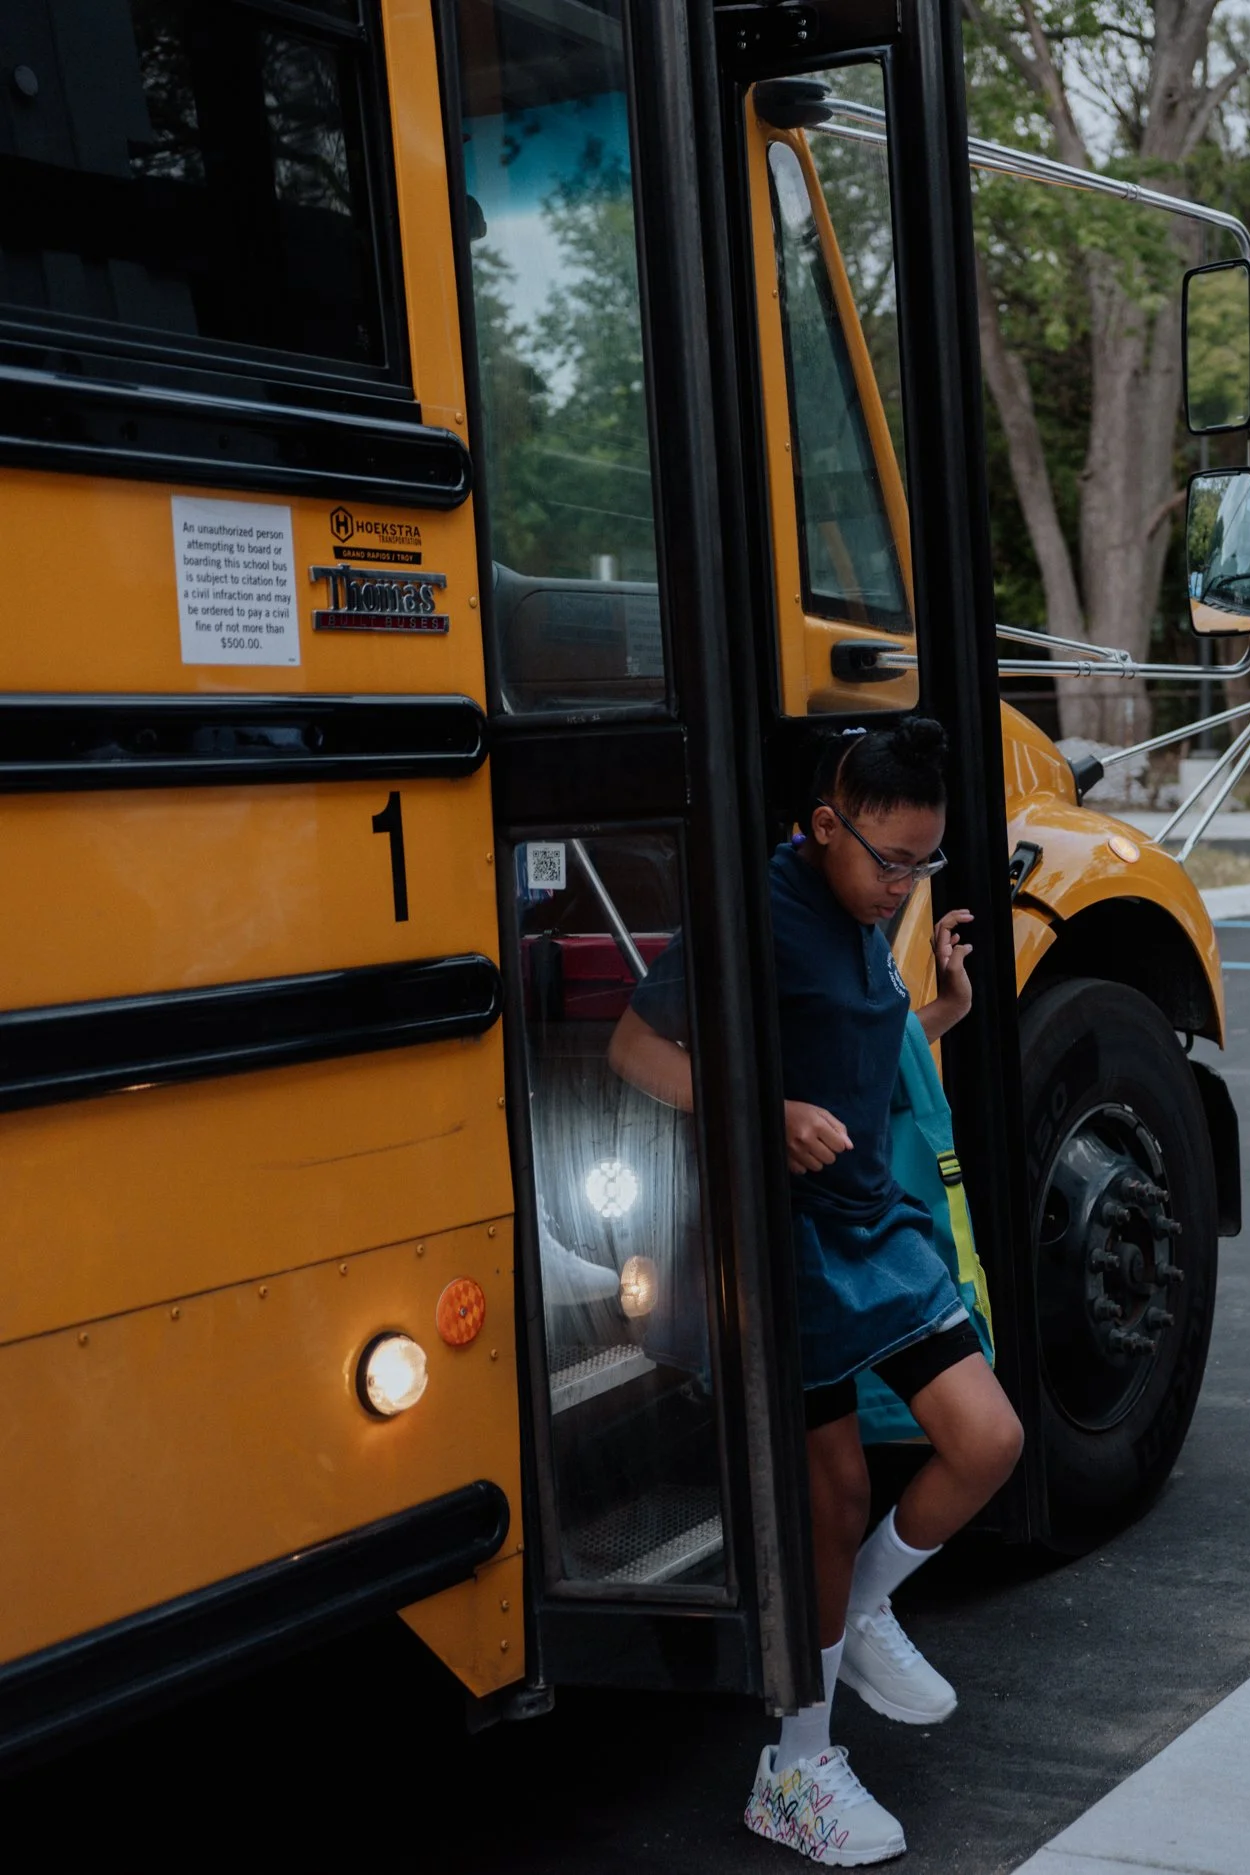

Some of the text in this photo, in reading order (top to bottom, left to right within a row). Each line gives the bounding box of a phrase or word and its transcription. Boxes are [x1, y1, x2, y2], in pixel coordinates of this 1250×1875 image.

[183, 521, 284, 540] An unauthorized person
[356, 520, 421, 538] HOEKSTRA
[186, 539, 282, 555] attempting to board or
[378, 534, 422, 546] TRANSPORTATION
[183, 554, 288, 572] boarding this school bus
[342, 549, 366, 559] GRAND
[366, 551, 390, 561] RAPIDS
[397, 553, 414, 562] TROY
[185, 571, 287, 587] is subject to citation for
[183, 588, 291, 605] a civil infraction and may
[309, 563, 447, 614] Thomas
[187, 604, 290, 620] be ordered to pay a civil
[195, 619, 285, 634] fine of not more than
[328, 614, 440, 629] BUILT BUSES
[220, 636, 263, 650] $500.00.
[371, 791, 409, 923] 1
